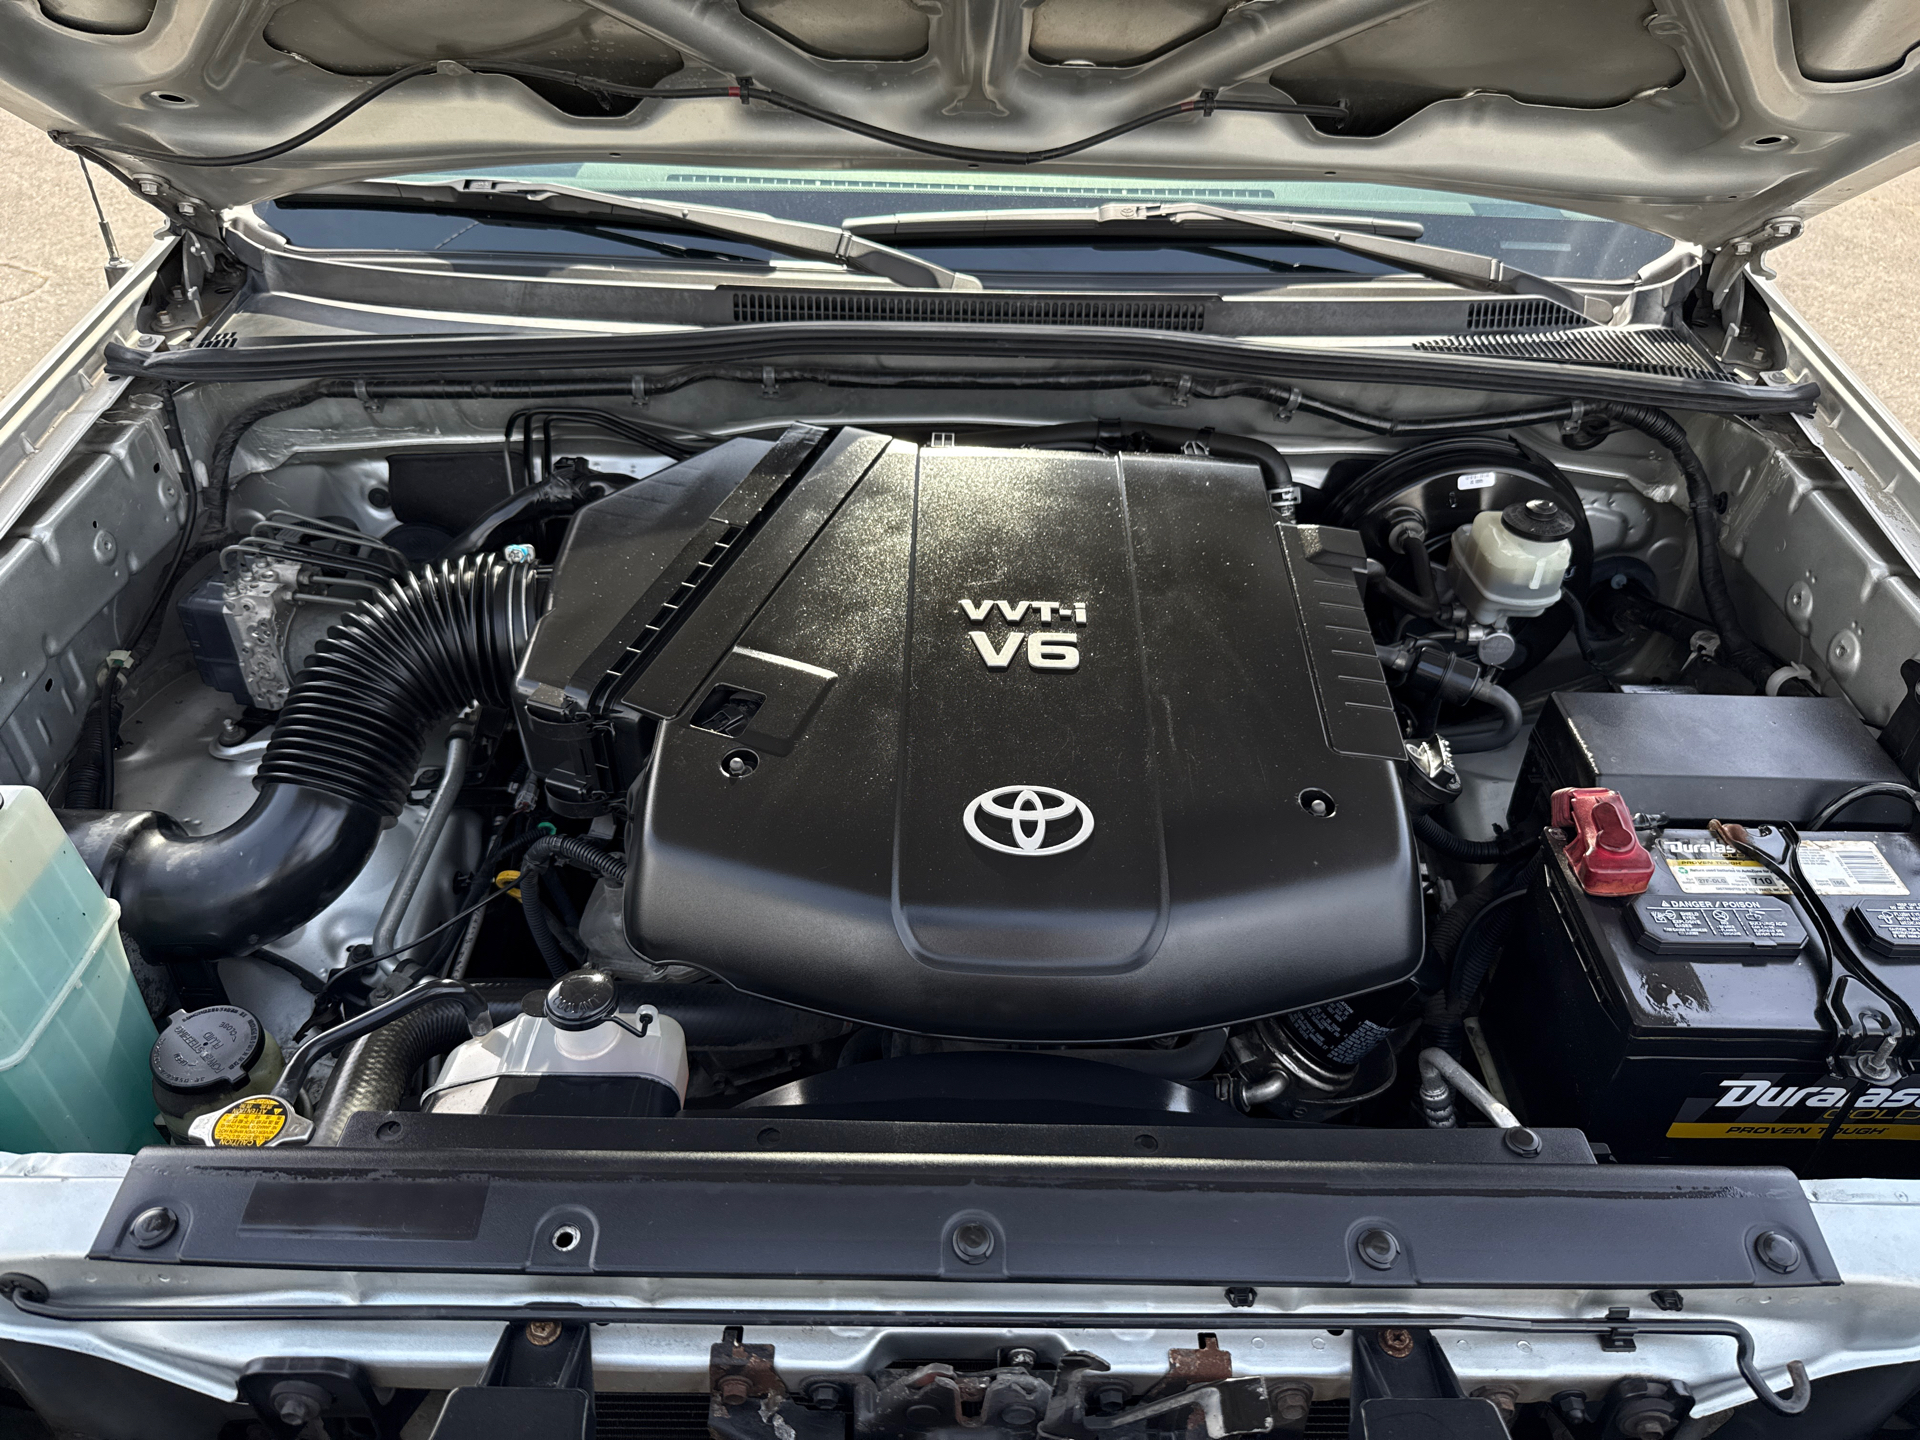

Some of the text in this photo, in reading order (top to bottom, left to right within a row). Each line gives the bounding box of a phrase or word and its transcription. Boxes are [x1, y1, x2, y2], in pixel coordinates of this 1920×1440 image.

[958, 599, 1087, 625] VVT-i
[968, 631, 1080, 670] V6
[1664, 841, 1737, 853] Duralas
[174, 1025, 205, 1054] STEERING
[202, 1031, 224, 1050] FLUID
[1715, 1080, 1920, 1108] Duraas
